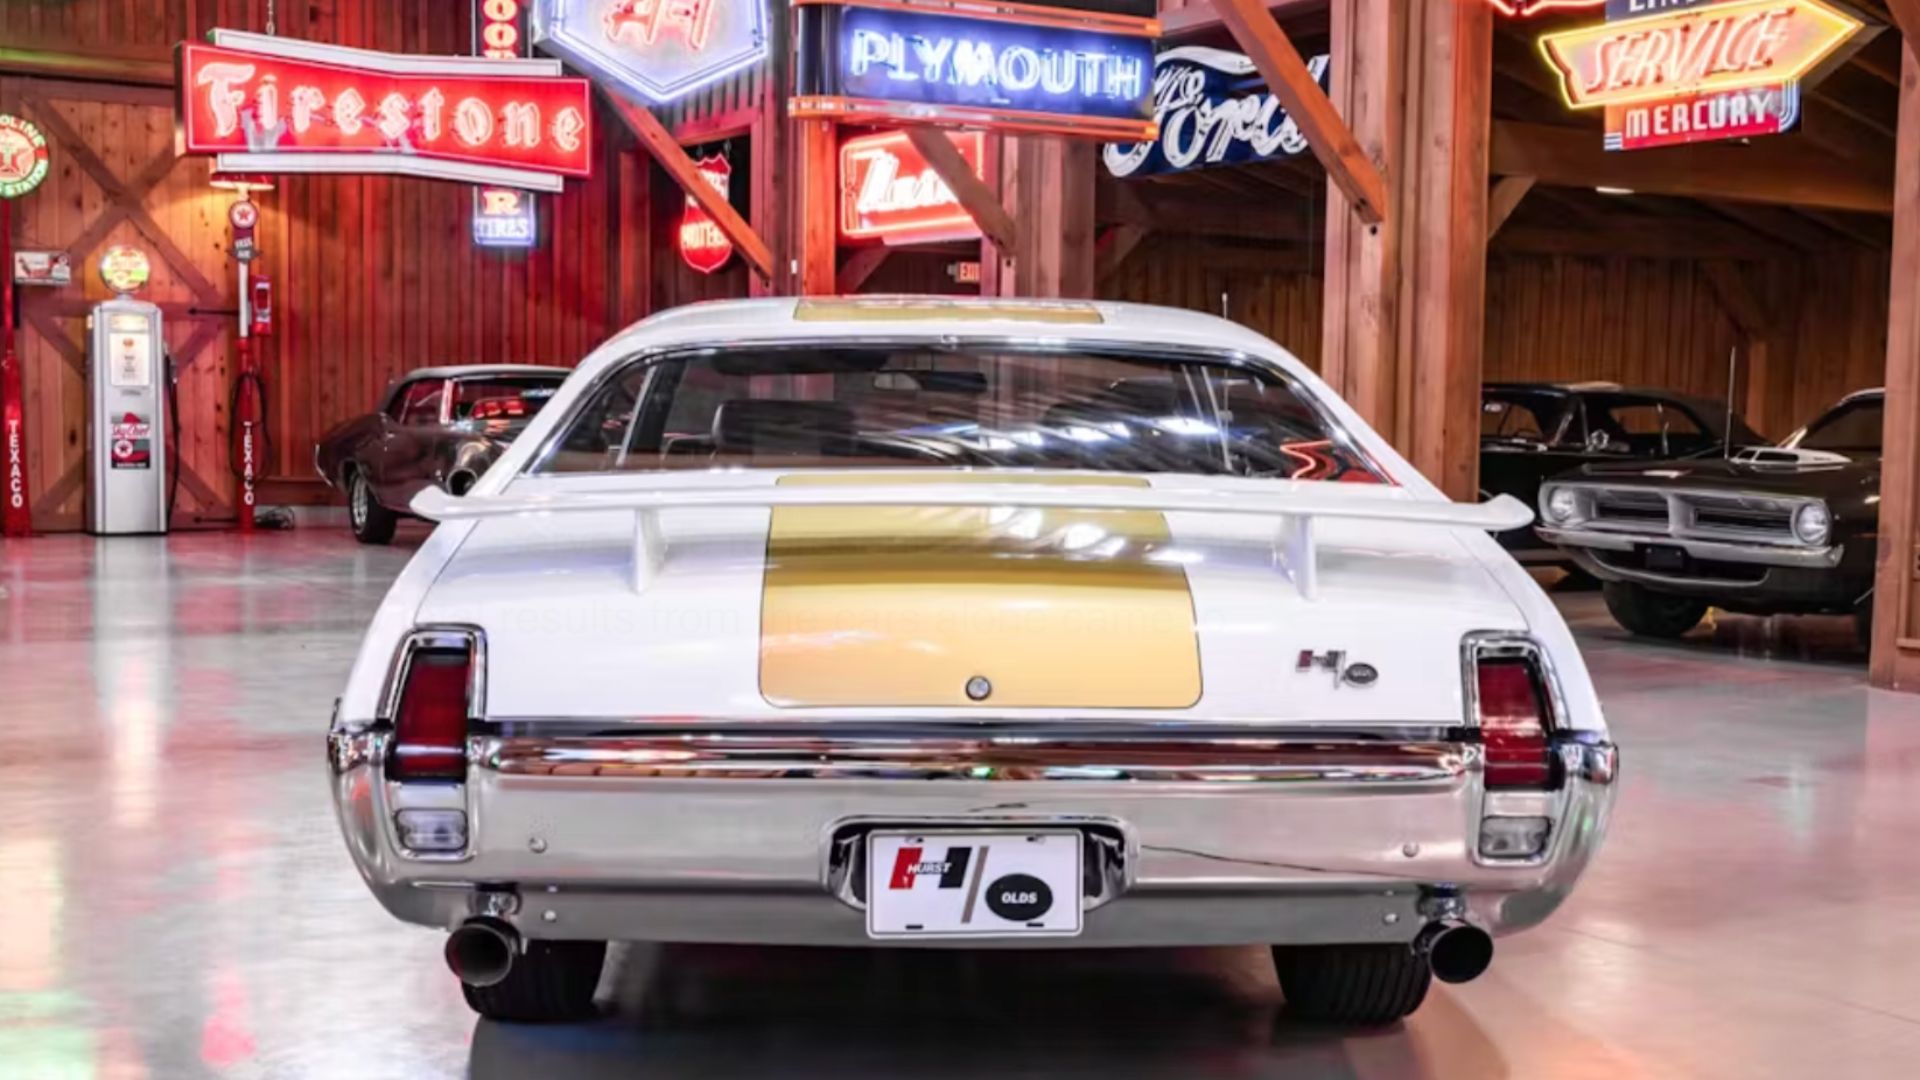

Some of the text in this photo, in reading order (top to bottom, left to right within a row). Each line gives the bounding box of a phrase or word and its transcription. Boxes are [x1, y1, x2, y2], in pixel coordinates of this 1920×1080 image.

[851, 29, 1142, 99] PLYMOUTH
[1585, 8, 1796, 92] SERVICE
[198, 62, 585, 151] Firestone
[1625, 92, 1773, 138] MERCURY
[478, 217, 529, 238] TIRES
[8, 419, 23, 508] TEXACO
[243, 421, 254, 506] TEXACO
[907, 862, 952, 875] HURST
[1001, 891, 1038, 904] OLDS
